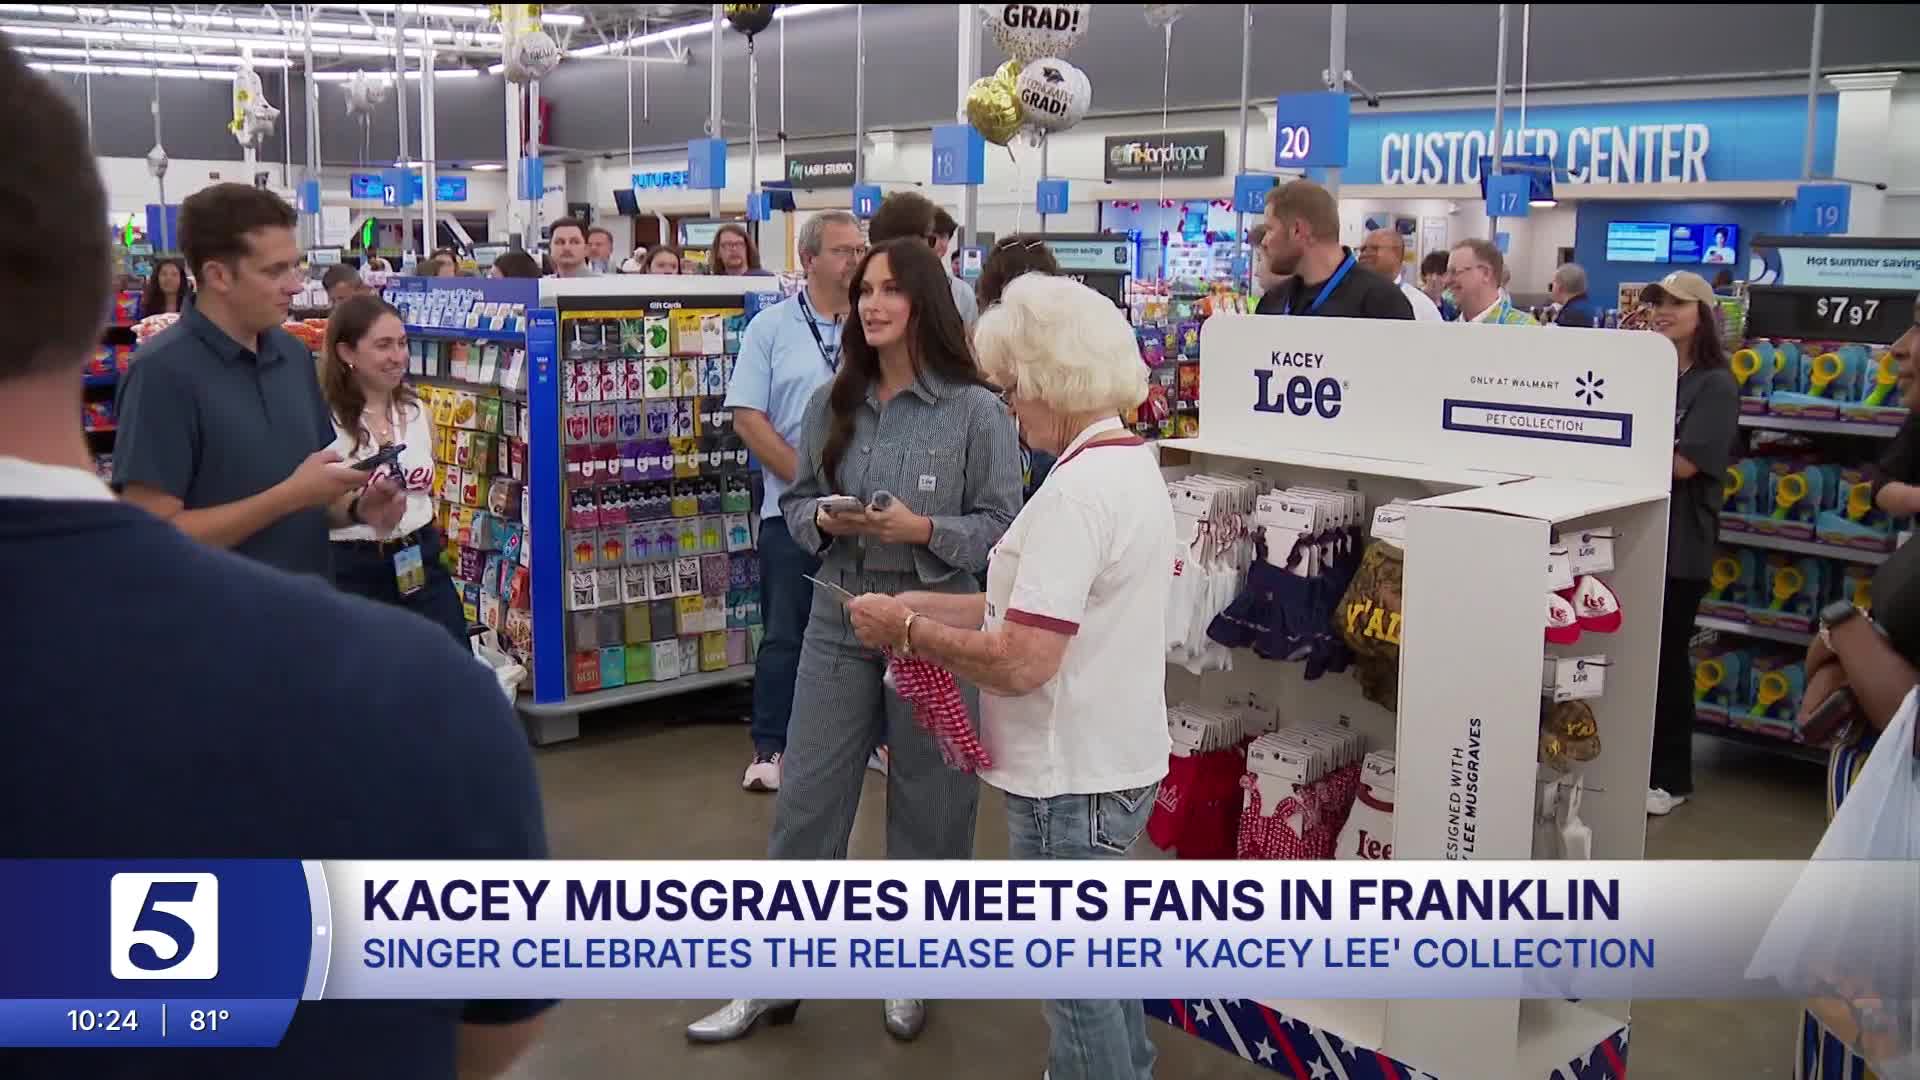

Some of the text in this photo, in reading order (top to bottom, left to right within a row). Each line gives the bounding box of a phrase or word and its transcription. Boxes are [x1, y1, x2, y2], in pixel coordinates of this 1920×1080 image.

[1003, 4, 1079, 32] GRAD!
[1021, 88, 1067, 117] GRAD!
[1280, 126, 1310, 159] 20
[937, 151, 953, 176] 18
[1567, 124, 1710, 184] CENTER
[804, 163, 823, 177] LASH
[1248, 191, 1263, 207] 15
[1501, 194, 1518, 212] 17
[1815, 206, 1839, 226] 19
[1806, 256, 1920, 270] Hot summer saving
[1271, 350, 1324, 369] KACEY
[1470, 376, 1494, 385] ONLY
[1512, 379, 1560, 390] WALMART
[1486, 412, 1584, 432] PET COLLECTION
[1346, 600, 1401, 644] Y'AL
[1463, 718, 1482, 852] LEE MUSGRAVES
[1446, 747, 1464, 860] ESIGNED WITH
